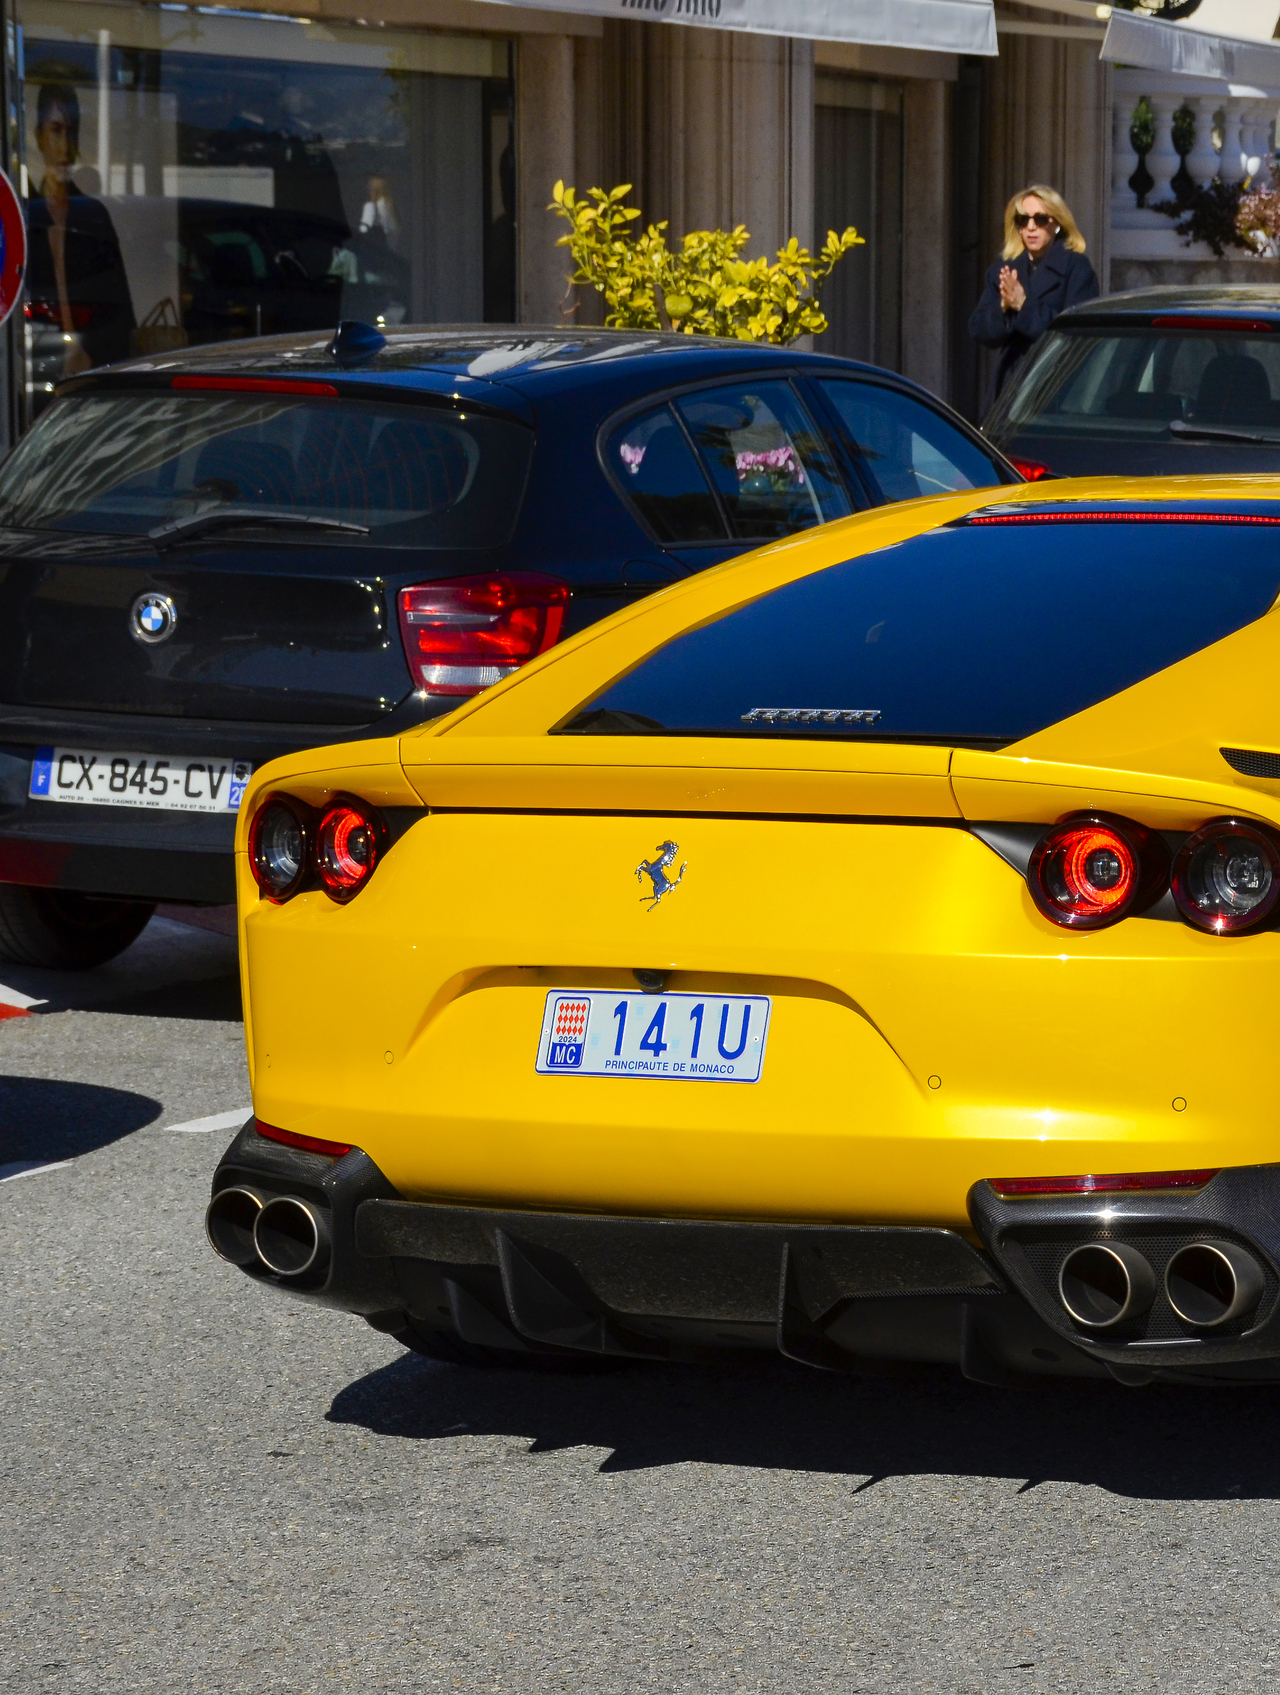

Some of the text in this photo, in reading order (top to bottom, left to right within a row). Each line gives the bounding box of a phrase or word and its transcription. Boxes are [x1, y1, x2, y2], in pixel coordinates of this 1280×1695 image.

[37, 774, 46, 787] F
[56, 754, 227, 800] CX-845-CV
[613, 1000, 751, 1060] 141U
[554, 1046, 577, 1065] MC
[604, 1060, 735, 1074] PRINCIPAUTE DE MONACO
